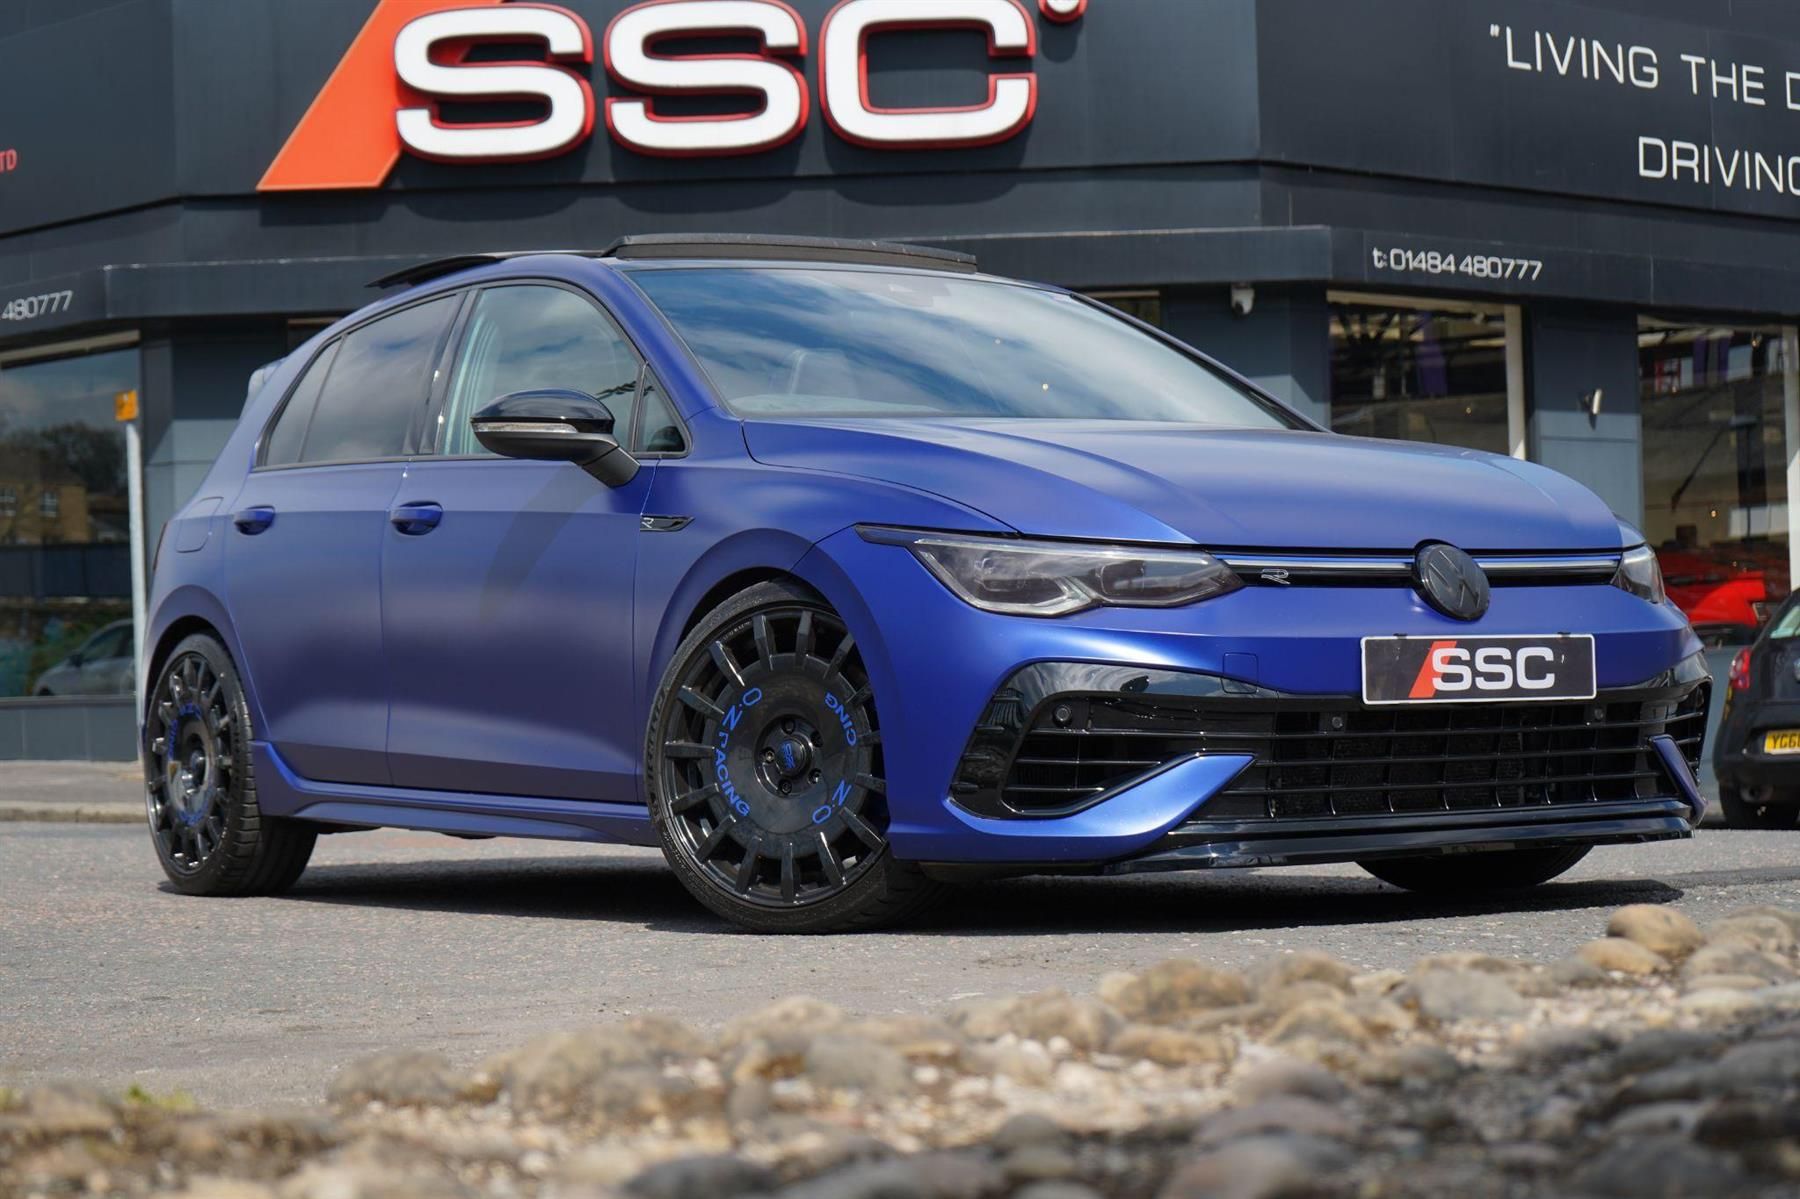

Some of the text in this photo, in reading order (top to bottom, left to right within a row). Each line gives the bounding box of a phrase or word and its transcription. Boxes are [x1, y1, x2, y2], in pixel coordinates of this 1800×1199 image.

[394, 0, 1037, 163] SSC
[1680, 54, 1766, 106] THE
[1458, 255, 1543, 281] 480777
[0, 290, 73, 321] 480777
[1432, 645, 1556, 692] SSC
